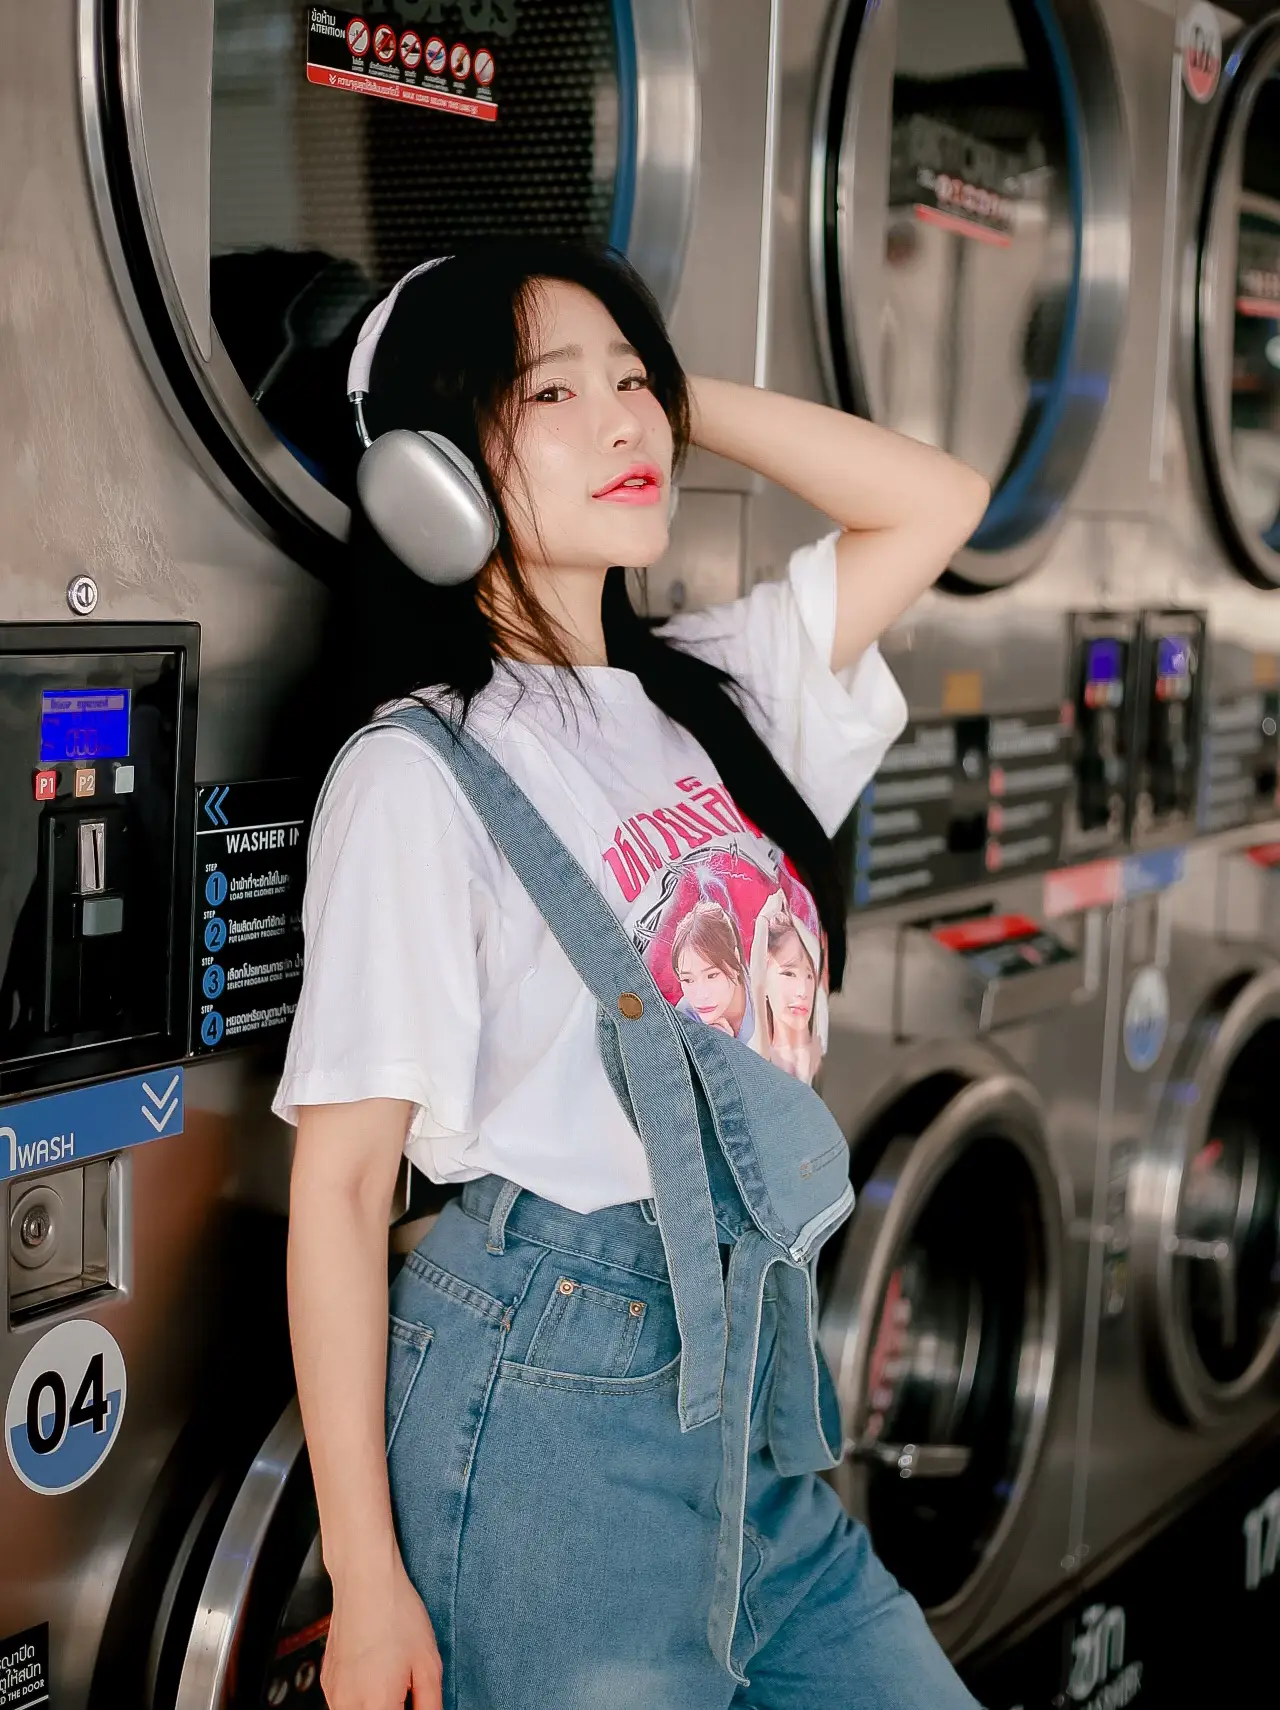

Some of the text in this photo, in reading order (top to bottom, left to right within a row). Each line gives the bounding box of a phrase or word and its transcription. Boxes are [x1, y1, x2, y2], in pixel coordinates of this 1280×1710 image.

[311, 8, 336, 26] ข้อห้าม
[310, 23, 345, 39] ATTENTION
[40, 777, 54, 794] P1
[79, 774, 95, 792] P2
[226, 829, 285, 854] WASHER
[205, 862, 218, 873] STEP
[203, 910, 216, 920] STEP
[210, 922, 221, 947] 2
[201, 956, 214, 967] STEP
[208, 969, 219, 994] 3
[201, 1004, 214, 1014] STEP
[207, 1016, 218, 1040] 4
[17, 1132, 74, 1169] WASH
[27, 1352, 109, 1455] 04
[8, 1689, 21, 1702] THE
[22, 1678, 45, 1696] DOOR
